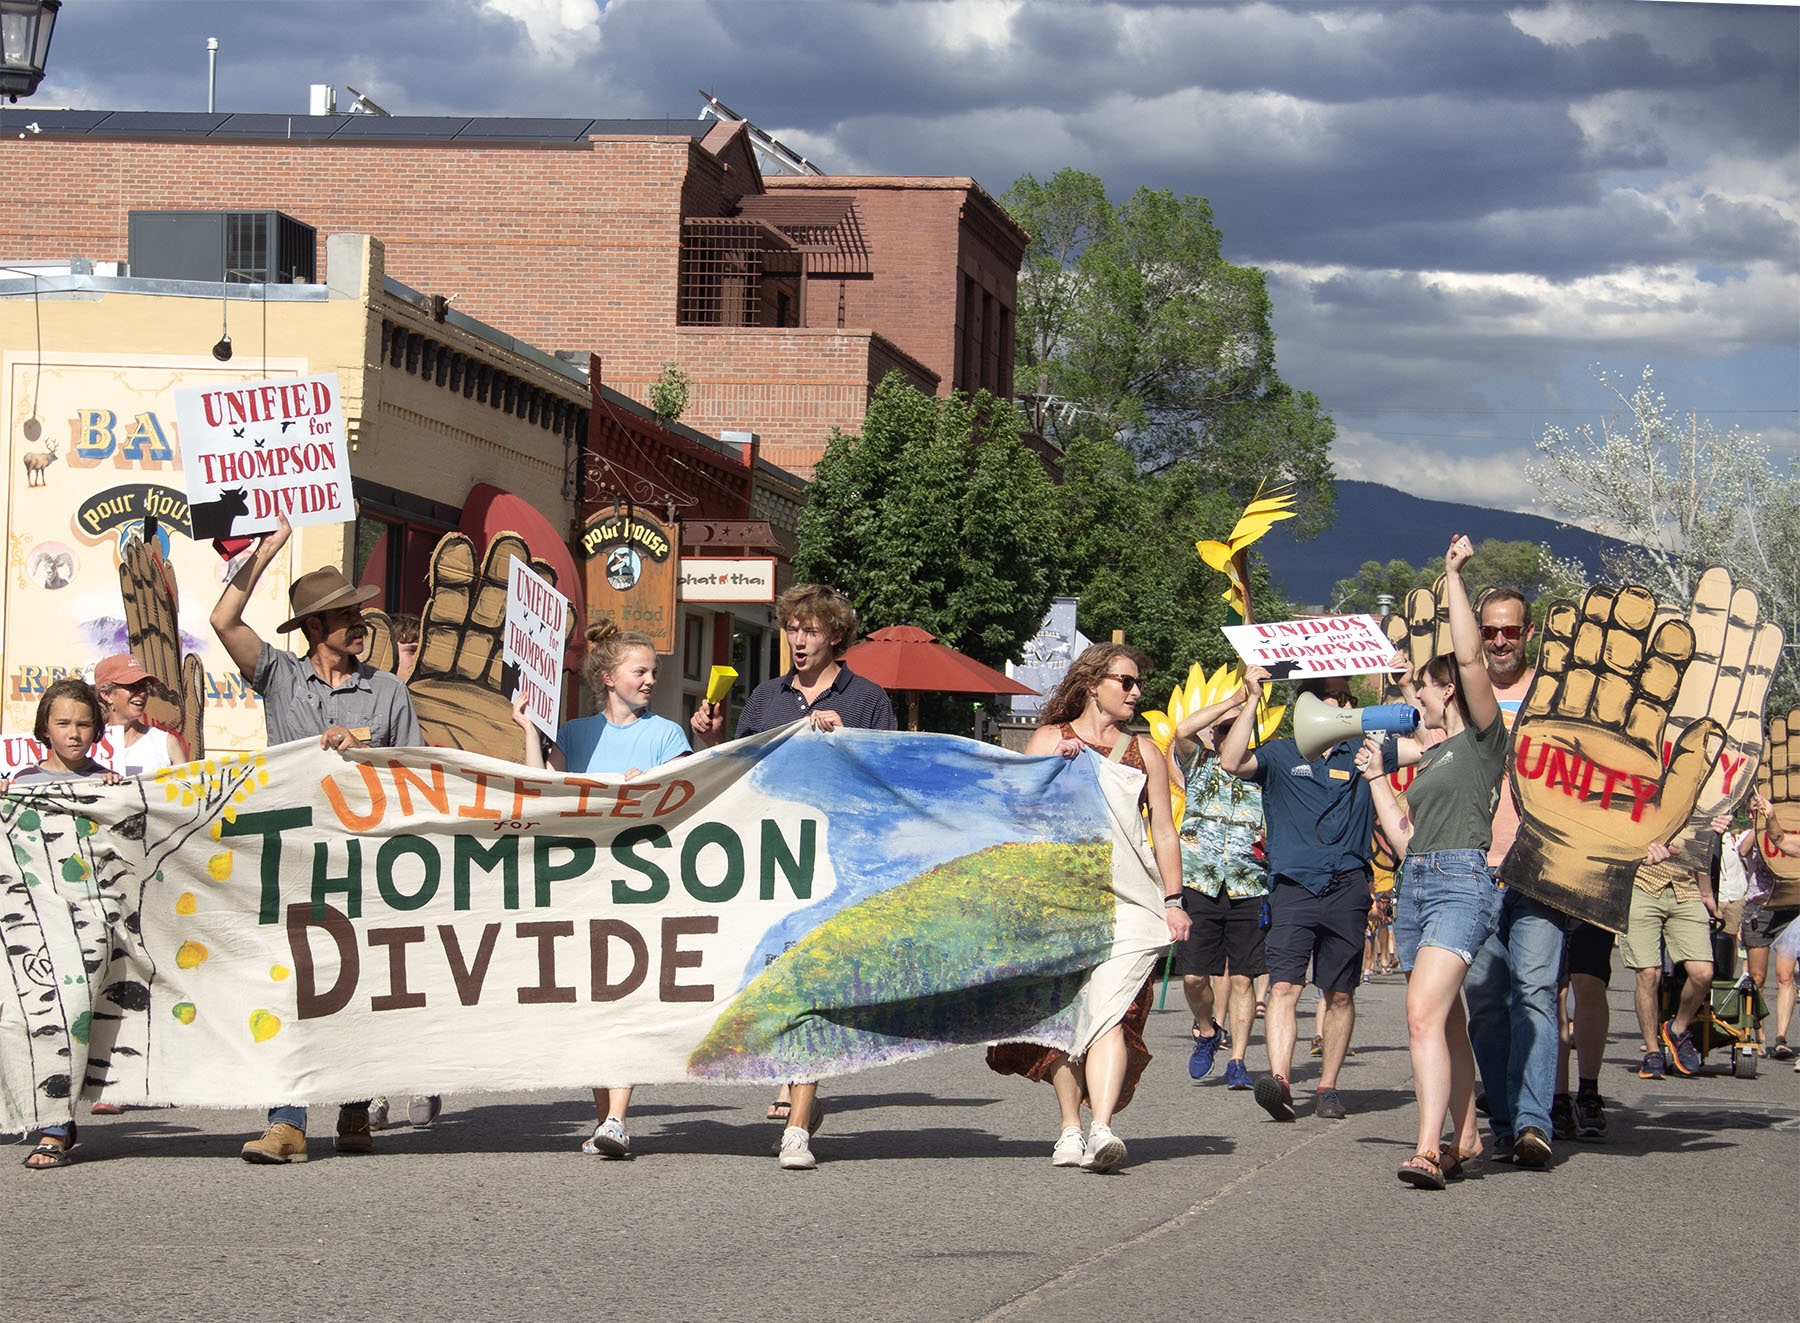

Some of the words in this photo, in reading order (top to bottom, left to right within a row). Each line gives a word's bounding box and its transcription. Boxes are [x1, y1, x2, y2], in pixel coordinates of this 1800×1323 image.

[201, 381, 331, 427] UNIFIED
[76, 408, 173, 461] BA
[308, 417, 332, 435] for
[198, 442, 336, 484] THOMPSON
[83, 493, 135, 532] pour
[252, 482, 341, 519] DIVIDE
[581, 521, 621, 555] pour
[623, 518, 668, 556] house
[730, 573, 765, 585] thai
[516, 567, 562, 632] UNIFIED
[621, 604, 664, 621] Food
[549, 630, 560, 652] for
[1256, 616, 1367, 639] UNIDOS
[1327, 633, 1353, 643] por
[509, 620, 558, 688] THOMPSON
[1253, 639, 1383, 660] THOMPSON
[1307, 653, 1390, 672] DIVIDE
[521, 670, 554, 726] DIVIDE
[321, 759, 696, 832] UNIFIED
[1516, 734, 1660, 823] UNITY
[493, 820, 541, 832] for
[223, 806, 817, 926] THOMPSON
[286, 902, 720, 1021] DIVIDE
